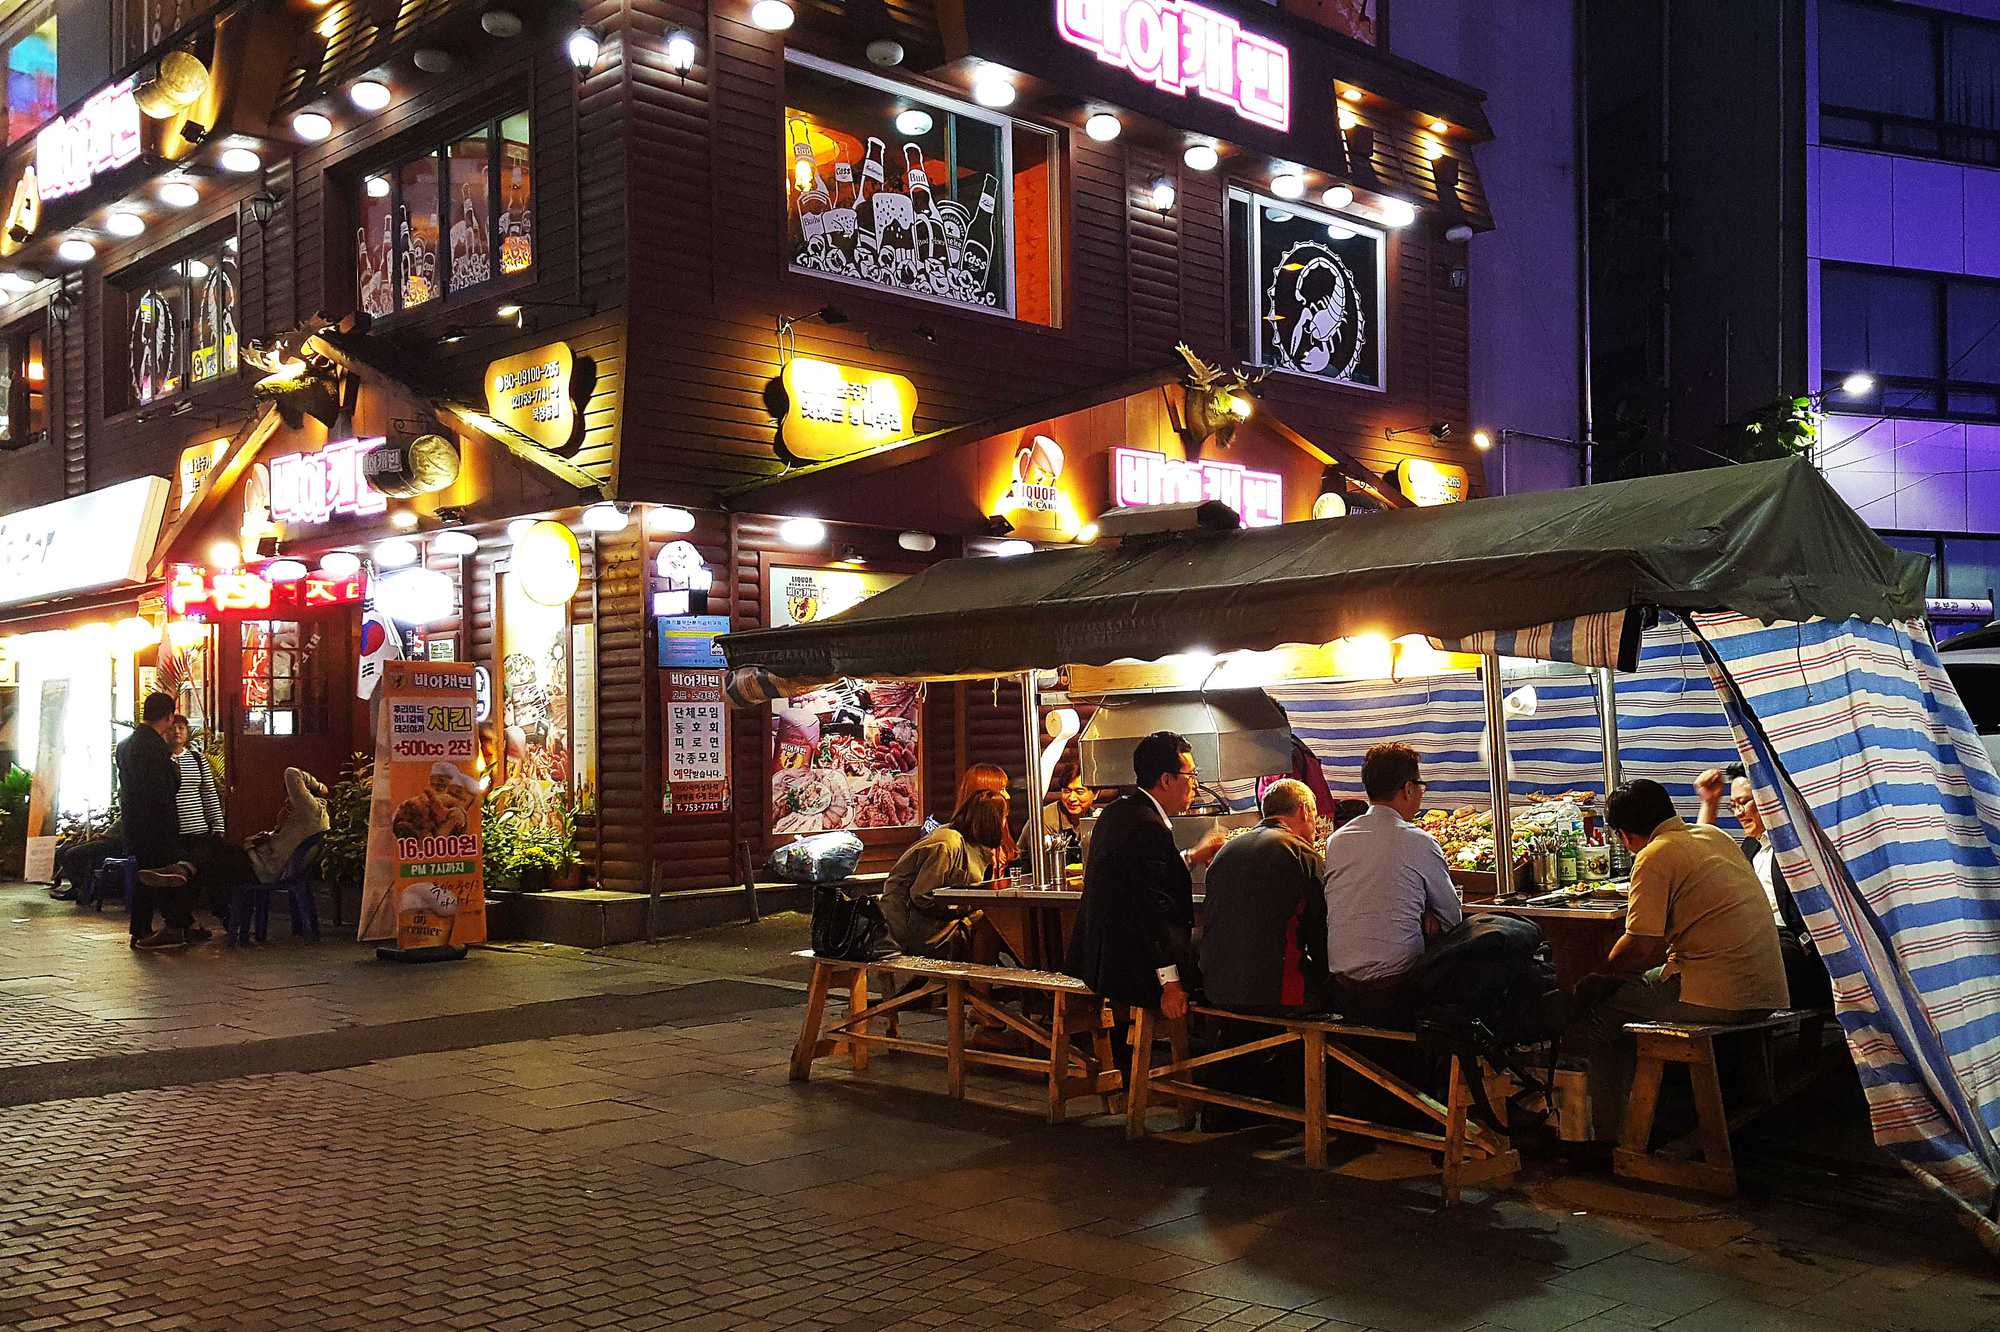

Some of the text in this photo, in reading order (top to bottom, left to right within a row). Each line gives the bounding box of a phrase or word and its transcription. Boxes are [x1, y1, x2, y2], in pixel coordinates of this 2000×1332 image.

[1061, 0, 1287, 129] 비어캐빈
[909, 172, 926, 182] Bud
[964, 251, 988, 270] Cass
[413, 673, 472, 689] 비어캐빈
[670, 672, 720, 688] 비어캐빈
[393, 704, 425, 714] 후라이드
[673, 706, 719, 719] 단체모임
[427, 705, 472, 732] 치킨
[393, 739, 473, 756] +500cc 2잔
[674, 752, 719, 765] 각종모임
[684, 802, 719, 812] 753-7741
[397, 833, 478, 860] 16,000원
[410, 862, 465, 875] PM 7시까지
